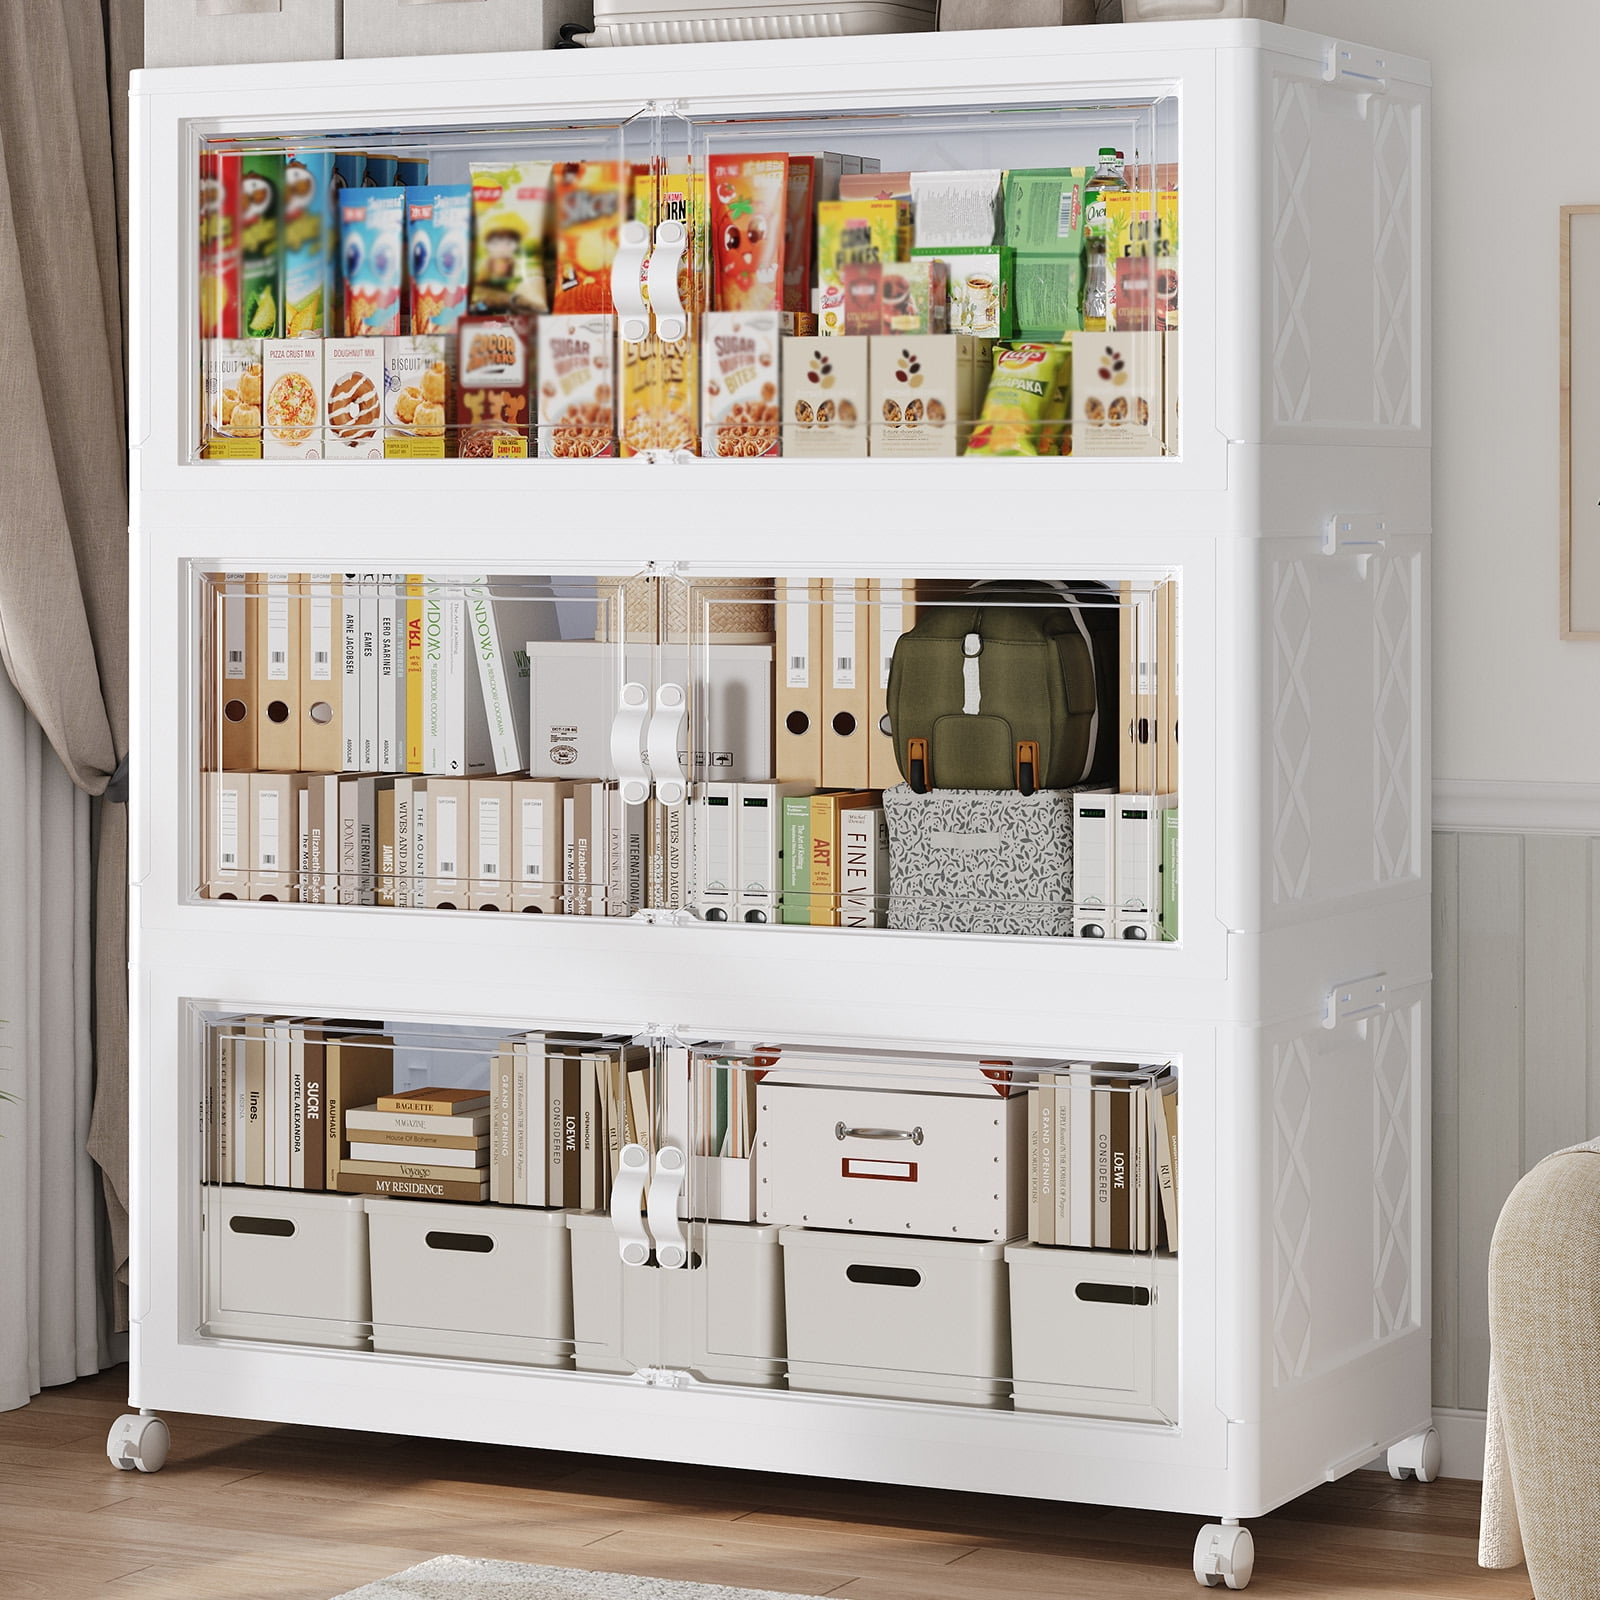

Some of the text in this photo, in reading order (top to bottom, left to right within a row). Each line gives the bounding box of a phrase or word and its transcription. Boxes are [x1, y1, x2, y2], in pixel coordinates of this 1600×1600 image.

[210, 360, 239, 373] BICUIT
[269, 349, 316, 359] PIZZA CRUST MIX
[333, 349, 375, 358] DOUGHNUT MIX
[391, 358, 421, 371] BISCUIT
[346, 614, 354, 675] ARNE JACOBSEN
[364, 632, 372, 657] EAMES
[383, 617, 391, 676] EERO SAARINEN
[399, 801, 407, 833] WIVES
[670, 810, 679, 843] WIVES
[312, 829, 320, 871] Elizabeth
[382, 845, 393, 872] JAMES
[399, 837, 407, 858] AND
[578, 838, 587, 882] Elizabeth
[670, 846, 679, 869] AND
[813, 838, 830, 867] ART
[847, 833, 867, 877] FINE
[250, 1091, 260, 1123] lines.
[307, 1081, 319, 1120] SUCRE
[395, 1102, 434, 1112] BAGUETTE
[329, 1099, 337, 1139] BAUHAUS
[394, 1119, 427, 1129] MAGAZINE
[553, 1099, 561, 1165] CONSIDERED
[566, 1116, 576, 1151] LOEWE
[1042, 1107, 1050, 1195] GRAND OPENING
[400, 1165, 431, 1178] Voyage
[1099, 1134, 1107, 1203] CONSIDERED
[1114, 1152, 1124, 1190] LOEWE
[1160, 1164, 1171, 1190] RUM
[376, 1180, 444, 1195] MY RESIDENCE
